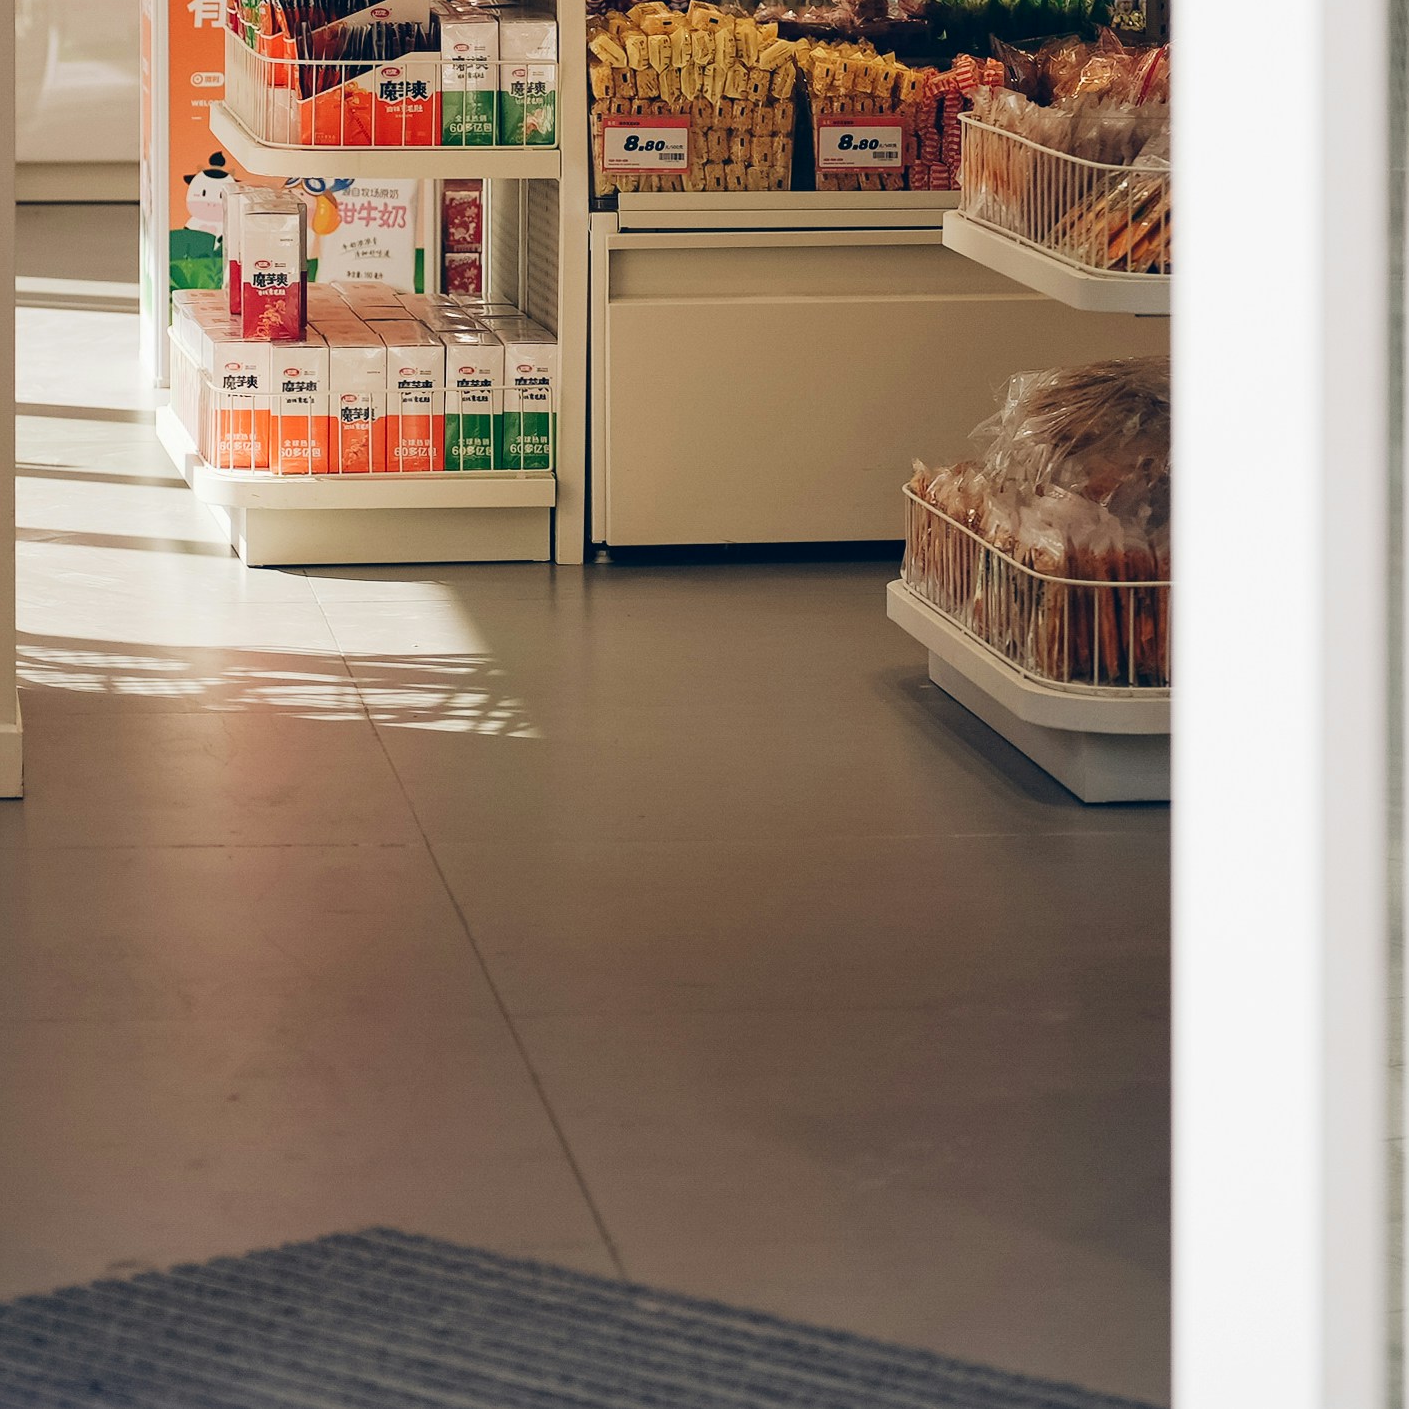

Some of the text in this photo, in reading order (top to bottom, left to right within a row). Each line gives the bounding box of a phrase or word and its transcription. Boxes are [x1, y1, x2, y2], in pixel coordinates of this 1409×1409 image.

[380, 80, 428, 101] 魔芋爽
[624, 135, 665, 152] 8.80
[838, 134, 879, 151] 8.80
[338, 201, 407, 229] 甜牛奶
[253, 272, 288, 287] 魔芋爽
[223, 375, 258, 389] 魔芋爽
